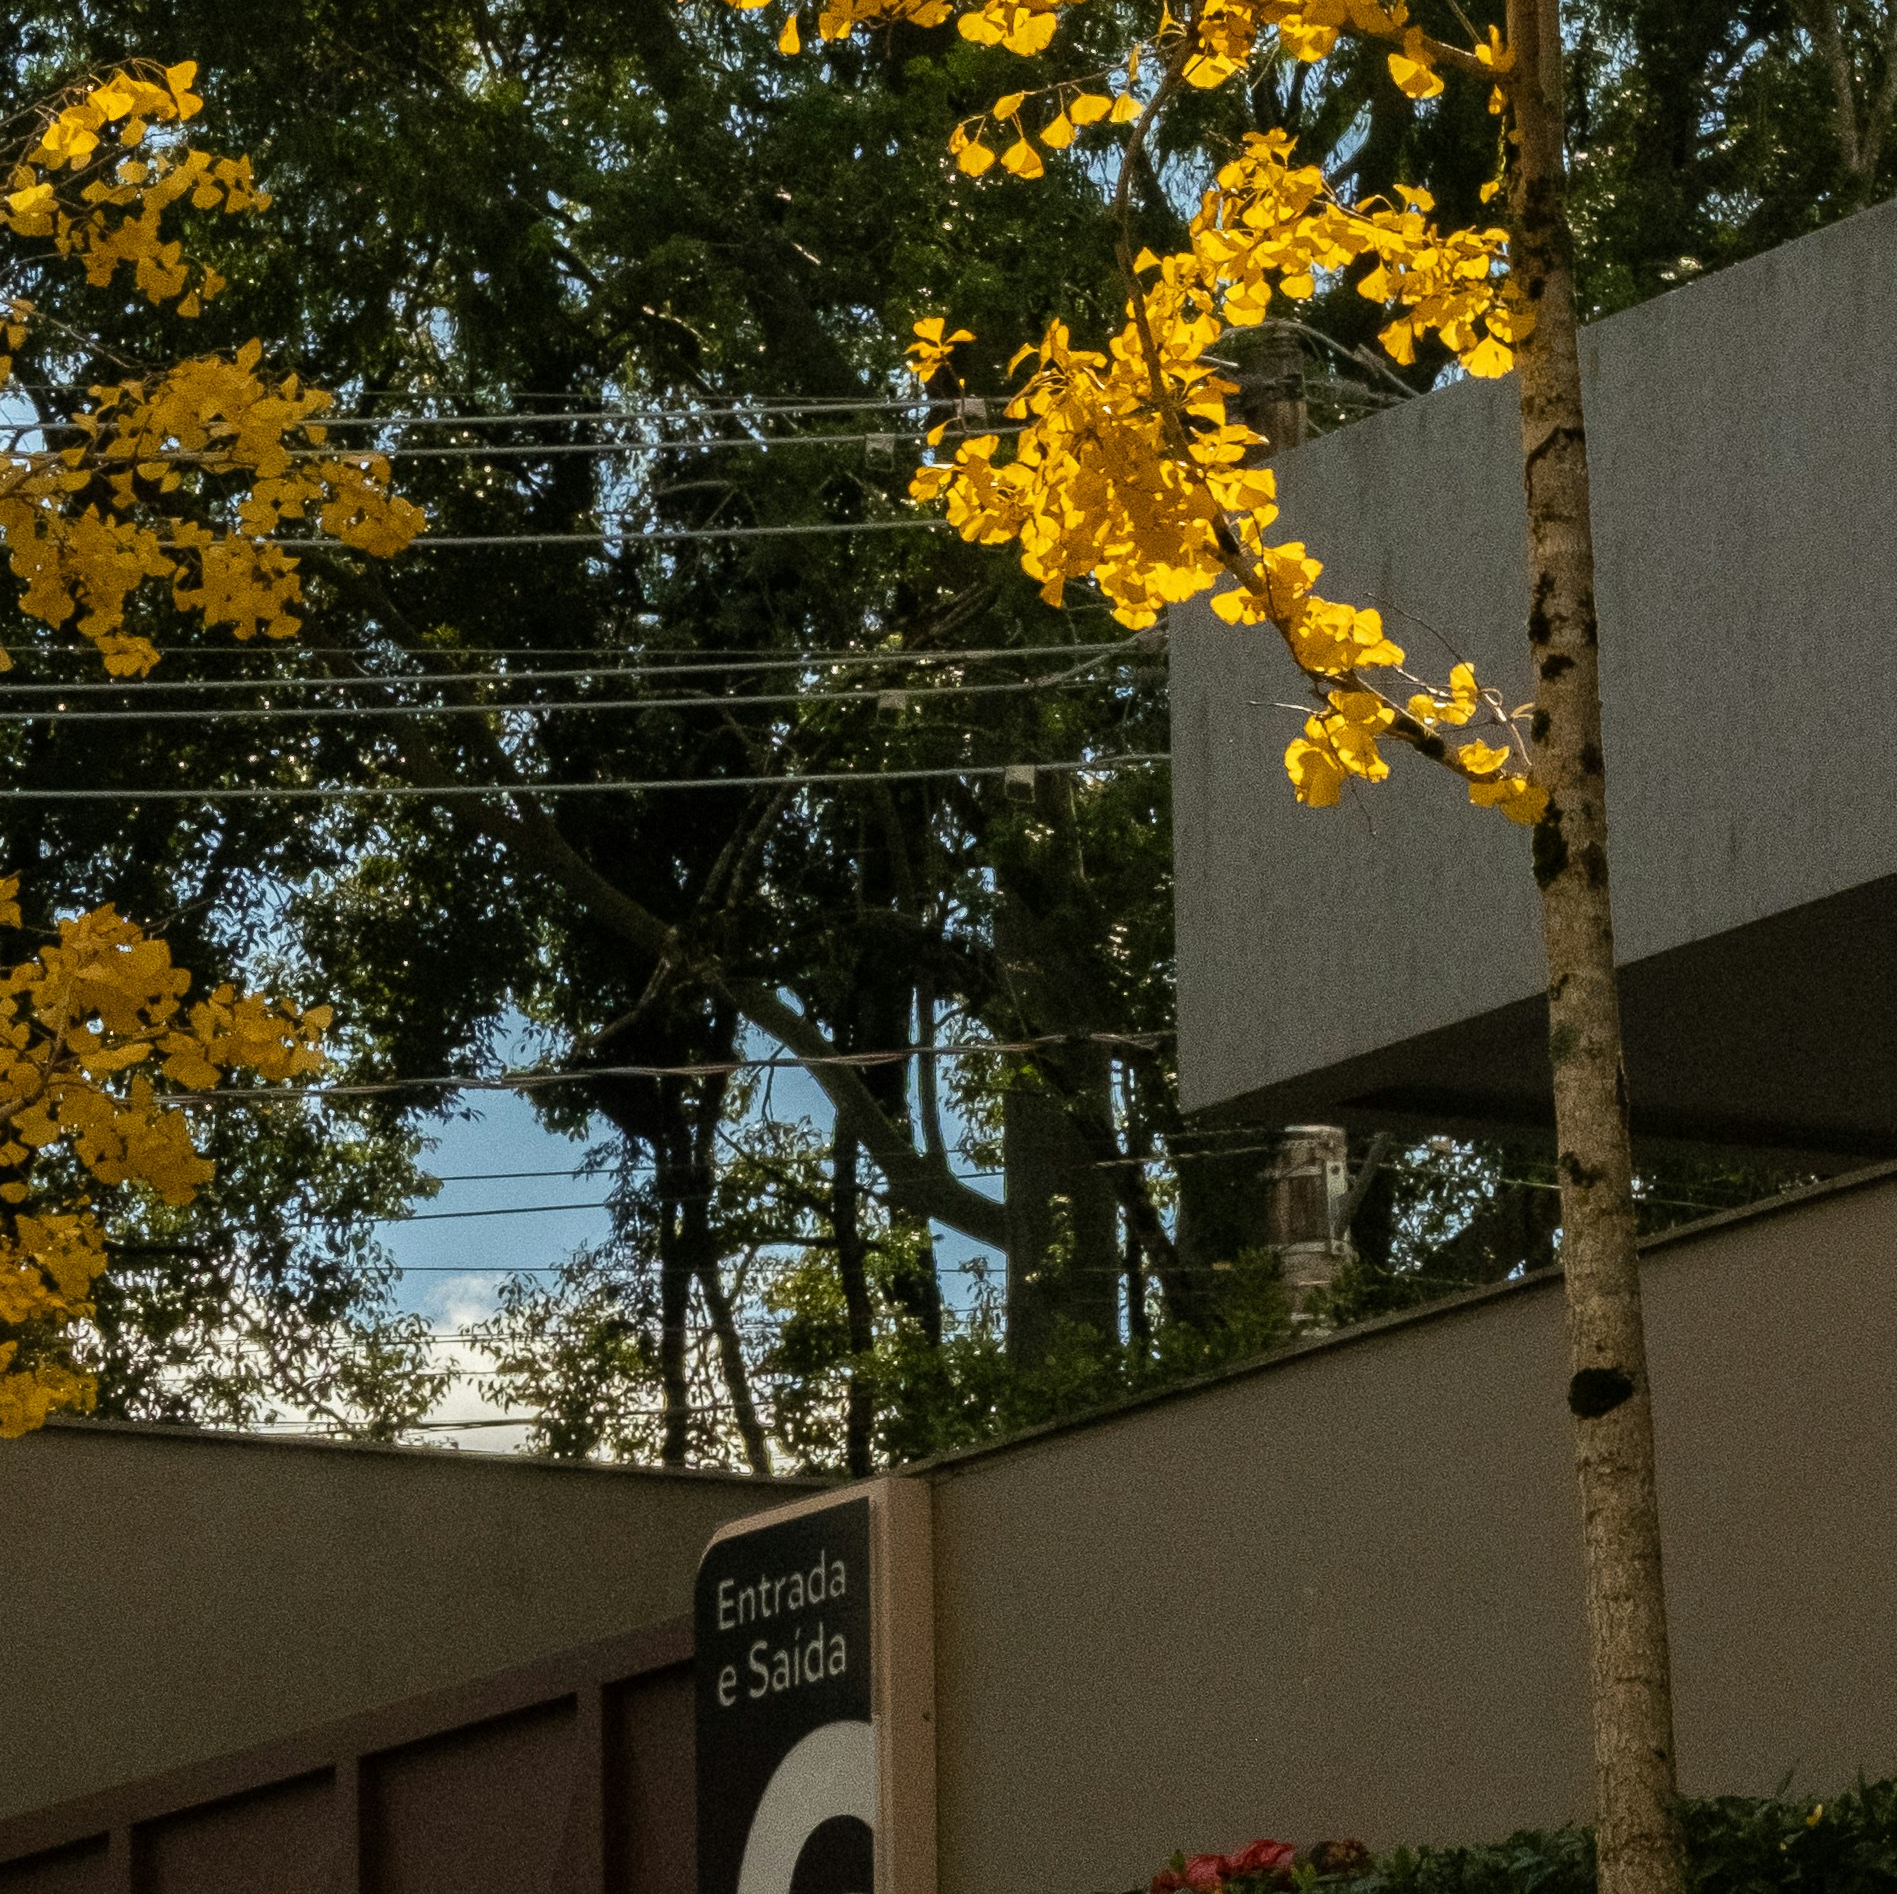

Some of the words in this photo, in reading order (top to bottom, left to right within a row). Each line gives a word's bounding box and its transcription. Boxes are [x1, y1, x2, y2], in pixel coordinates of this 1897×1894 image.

[717, 1548, 847, 1631] Entrada
[717, 1664, 737, 1707] e
[748, 1621, 847, 1699] Saída
